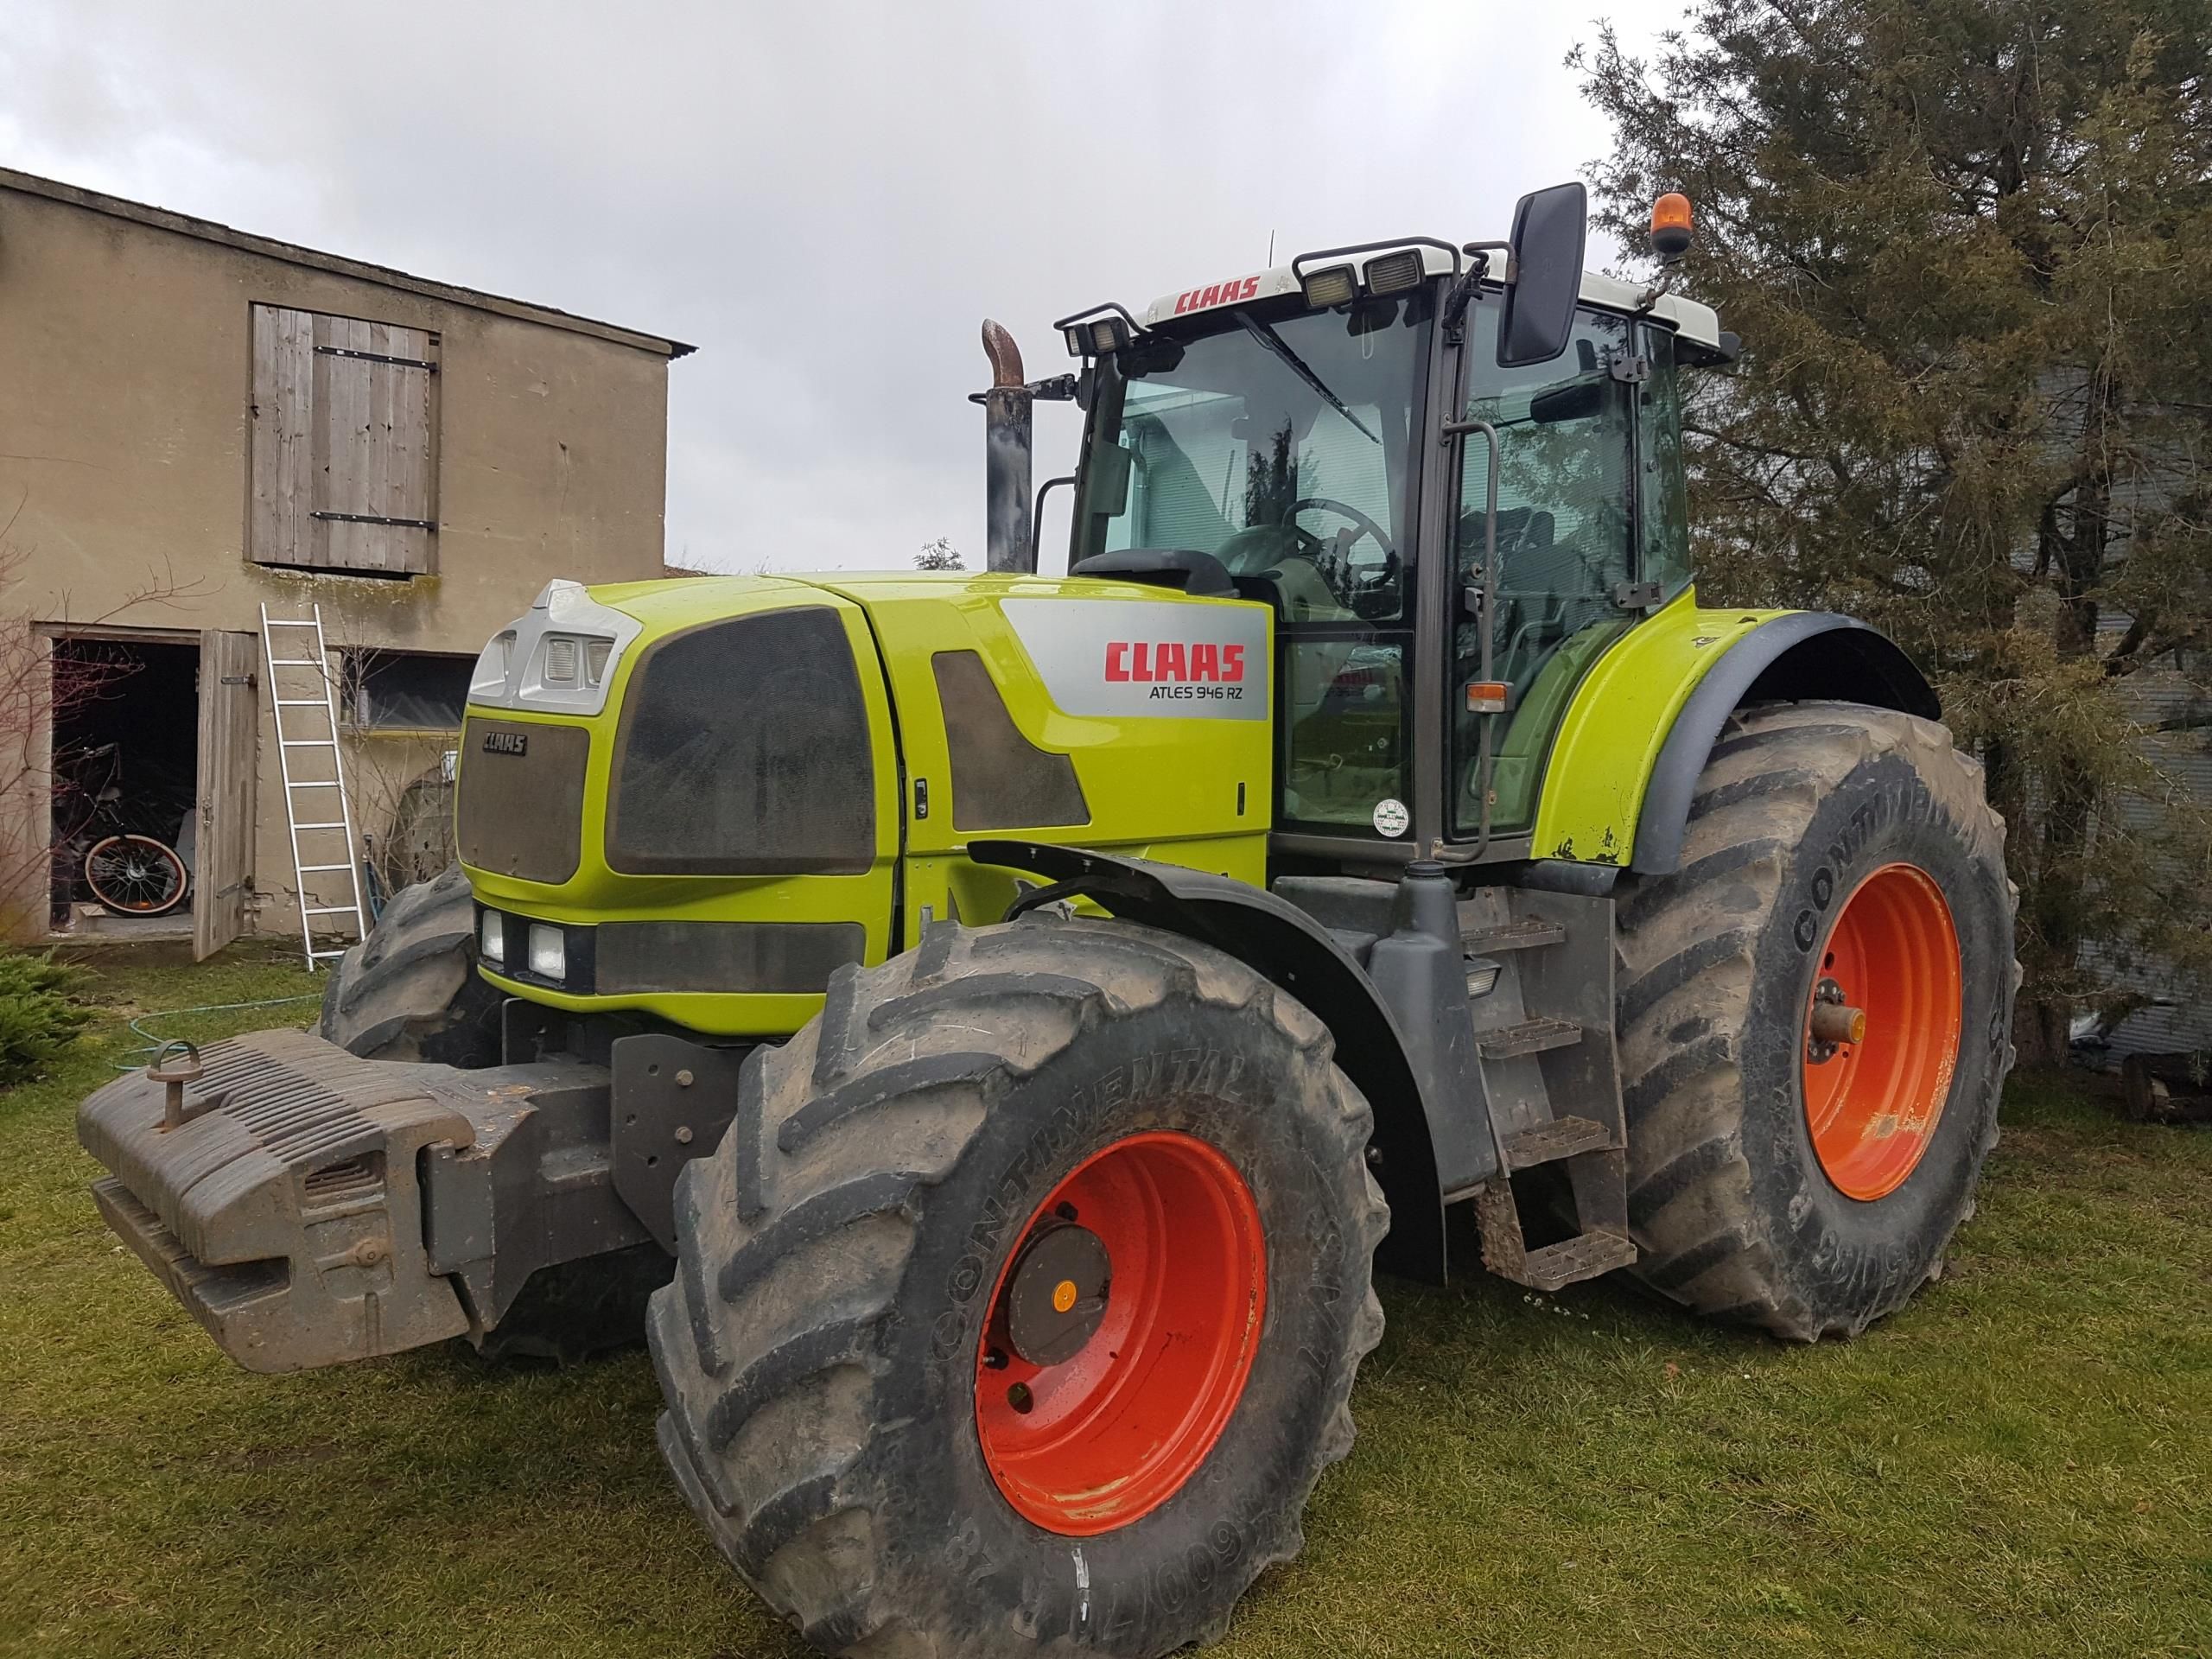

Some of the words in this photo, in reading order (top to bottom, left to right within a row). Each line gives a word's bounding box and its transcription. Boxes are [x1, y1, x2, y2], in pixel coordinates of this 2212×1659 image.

[1174, 276, 1261, 315] CLAAS
[1105, 642, 1244, 682] CLAAS
[1149, 686, 1192, 699] ATLES
[1197, 686, 1224, 700] 946
[1226, 687, 1243, 700] RZ
[483, 732, 527, 756] CLAAS
[931, 1047, 1245, 1362] CONTINENTAL
